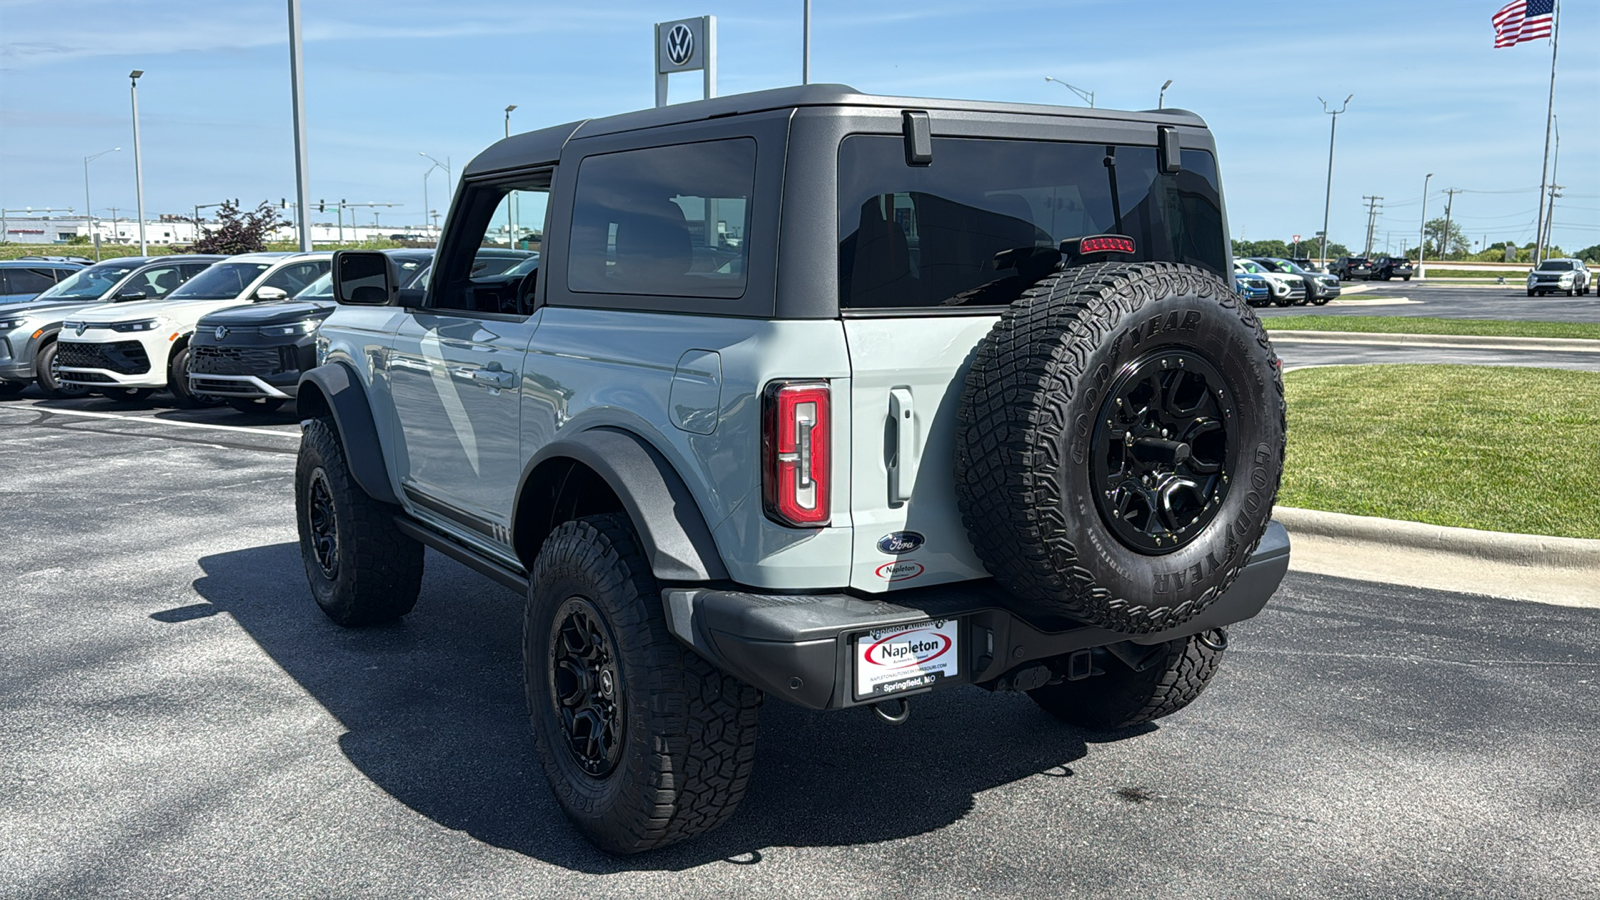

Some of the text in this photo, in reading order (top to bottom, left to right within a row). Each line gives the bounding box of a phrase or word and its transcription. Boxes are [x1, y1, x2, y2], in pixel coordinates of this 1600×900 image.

[667, 24, 693, 65] VW
[889, 536, 916, 551] Ford
[885, 565, 916, 575] Napleton
[881, 640, 939, 658] Napleton
[883, 674, 936, 692] Springfield, MO
